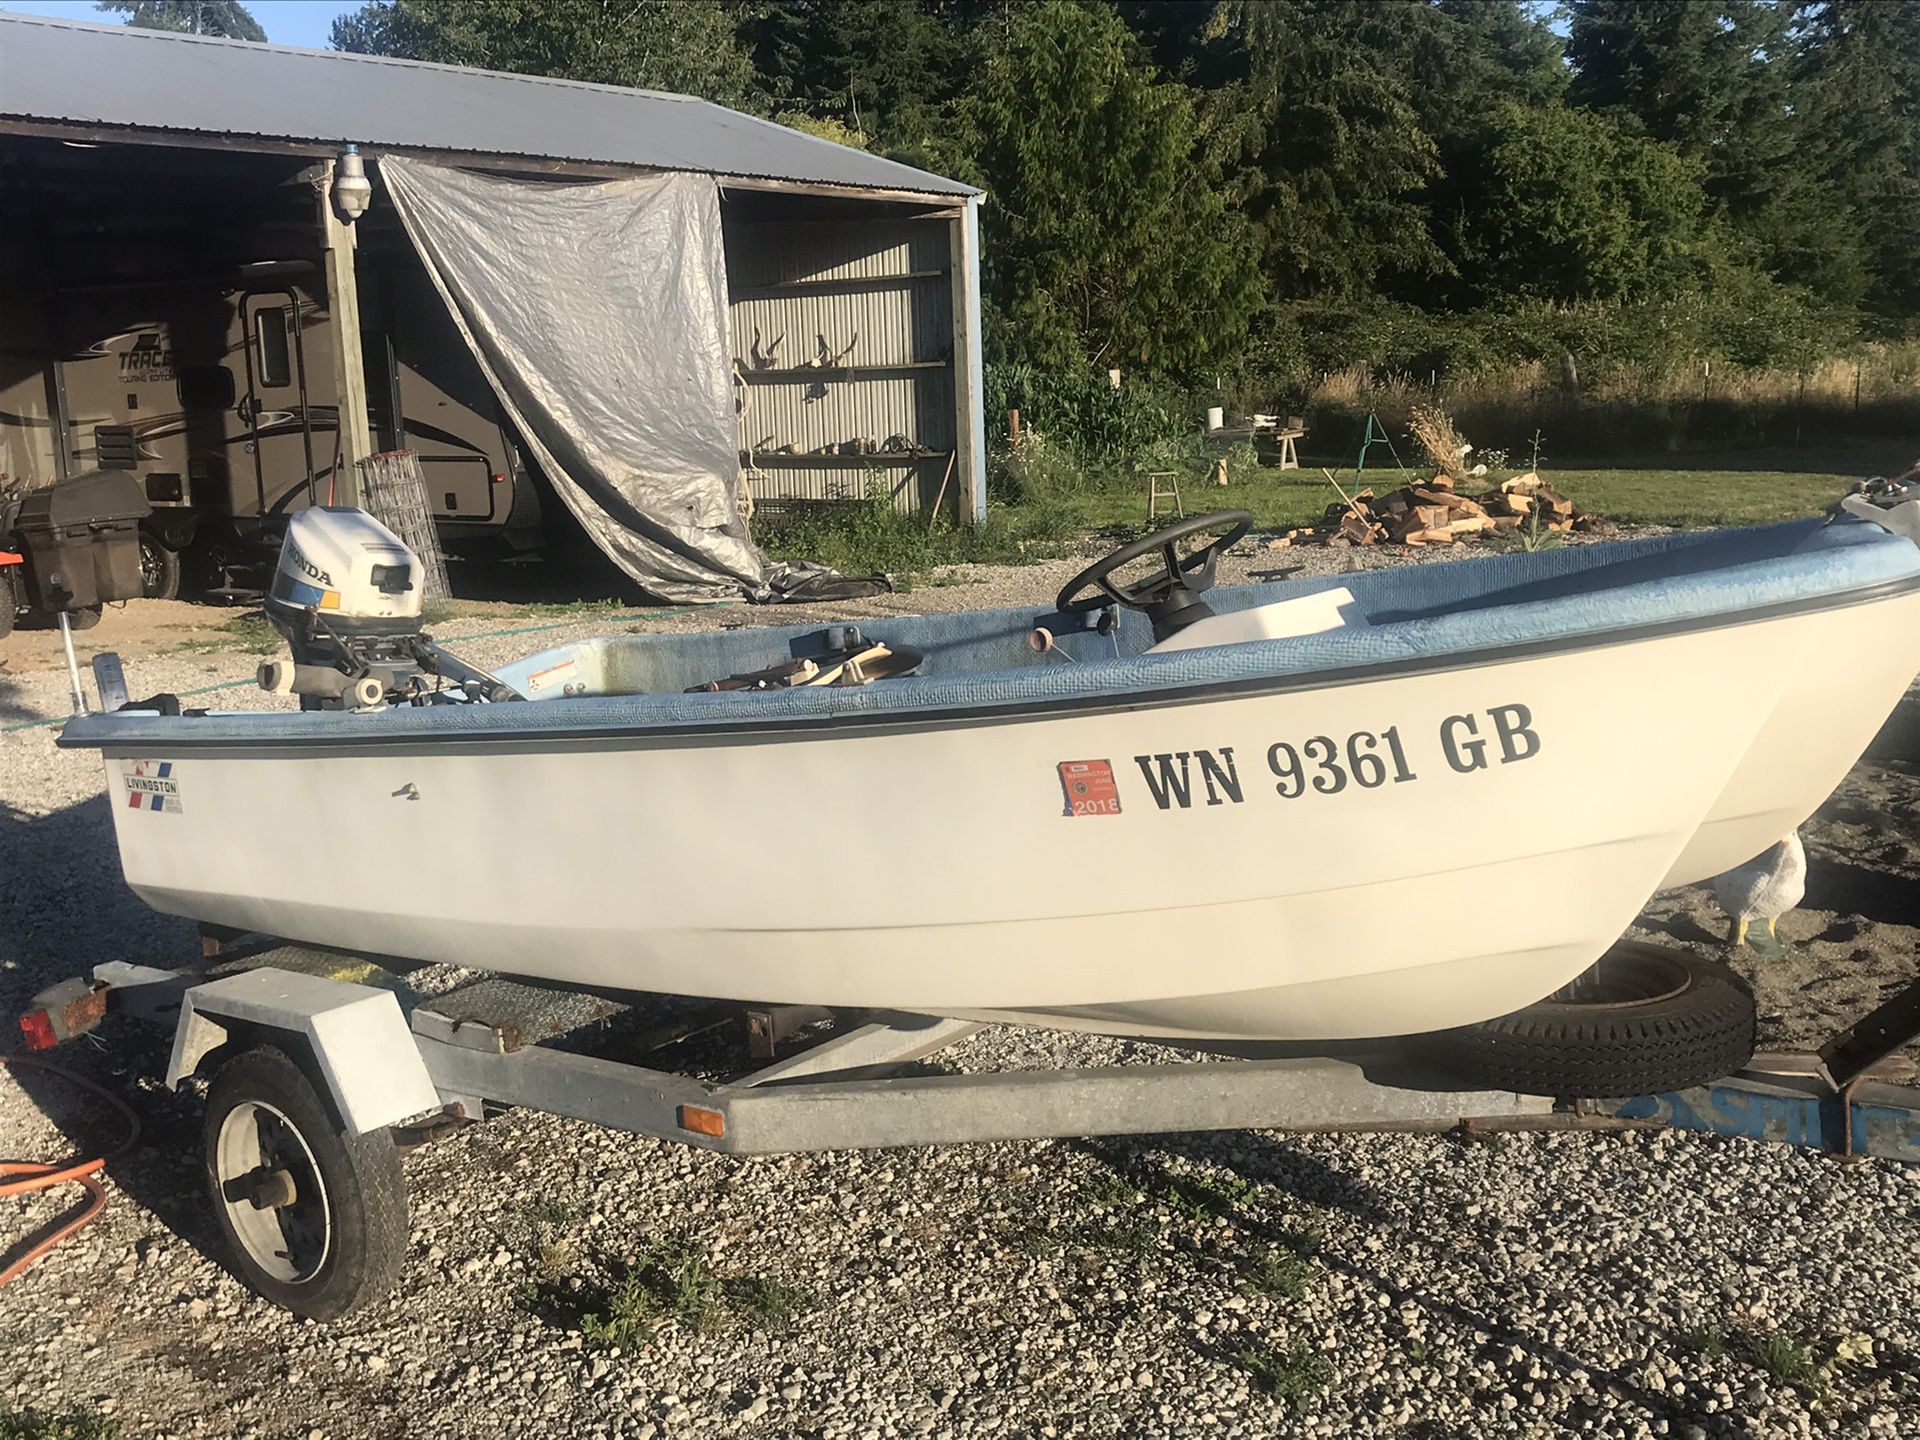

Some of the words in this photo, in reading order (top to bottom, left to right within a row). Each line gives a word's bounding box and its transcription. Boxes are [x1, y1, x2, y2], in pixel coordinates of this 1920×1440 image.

[287, 542, 334, 587] HONDA
[1134, 747, 1243, 809] WN
[1268, 726, 1416, 798] 9361
[1440, 704, 1539, 772] GB
[126, 777, 177, 794] LIVINGSTON
[1074, 798, 1118, 813] 2018
